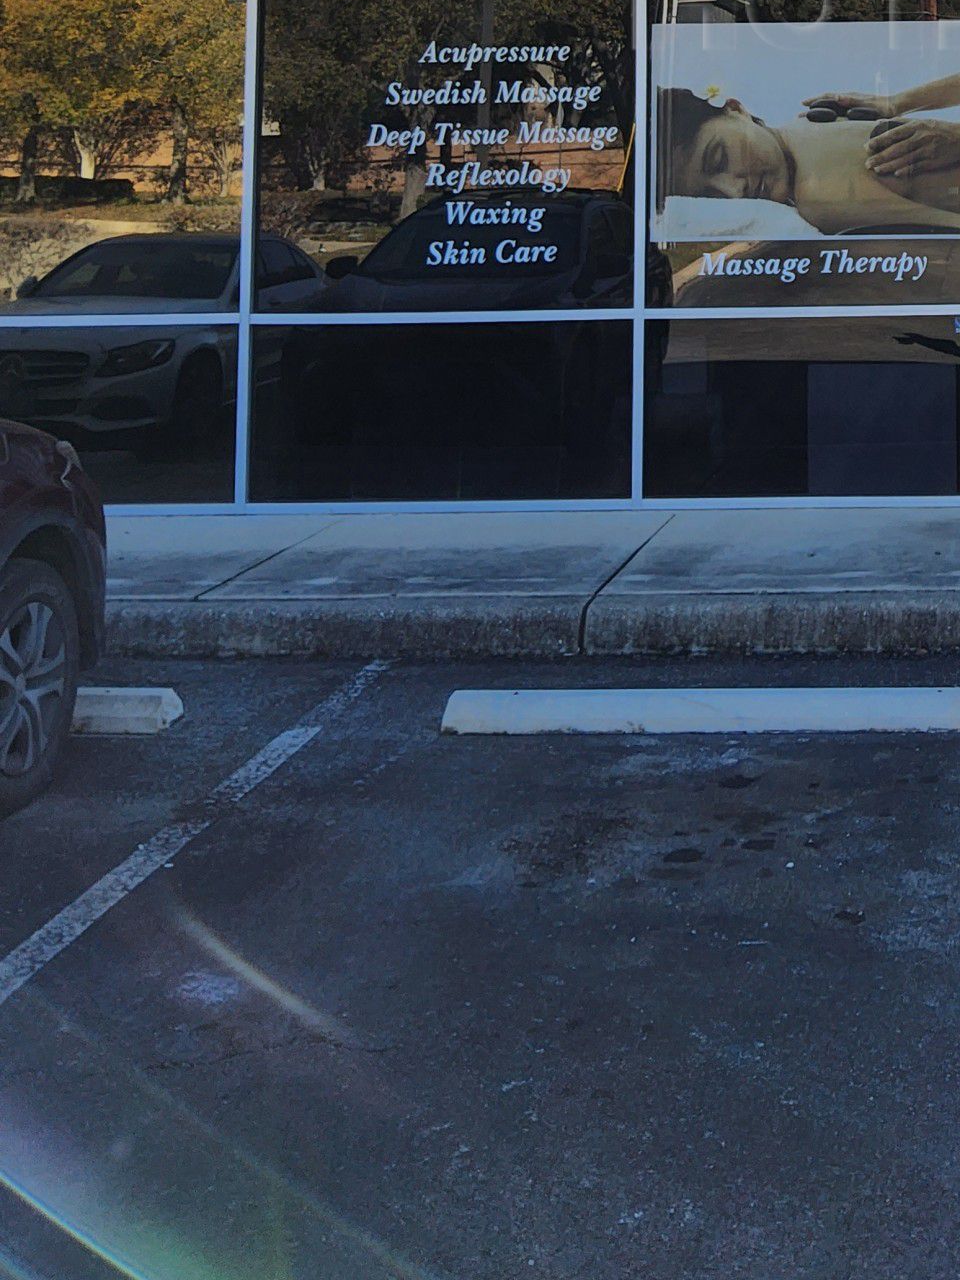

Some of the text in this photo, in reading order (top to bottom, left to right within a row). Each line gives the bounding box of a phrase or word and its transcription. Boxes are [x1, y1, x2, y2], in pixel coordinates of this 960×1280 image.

[418, 41, 571, 71] Acupressure
[385, 80, 602, 111] Swedish Massage
[366, 122, 619, 154] Deep Tissue Massage
[425, 163, 572, 194] Reflexology
[445, 201, 546, 233] Waxing
[426, 240, 558, 266] Skin Care
[697, 249, 928, 283] Massage Therapy
